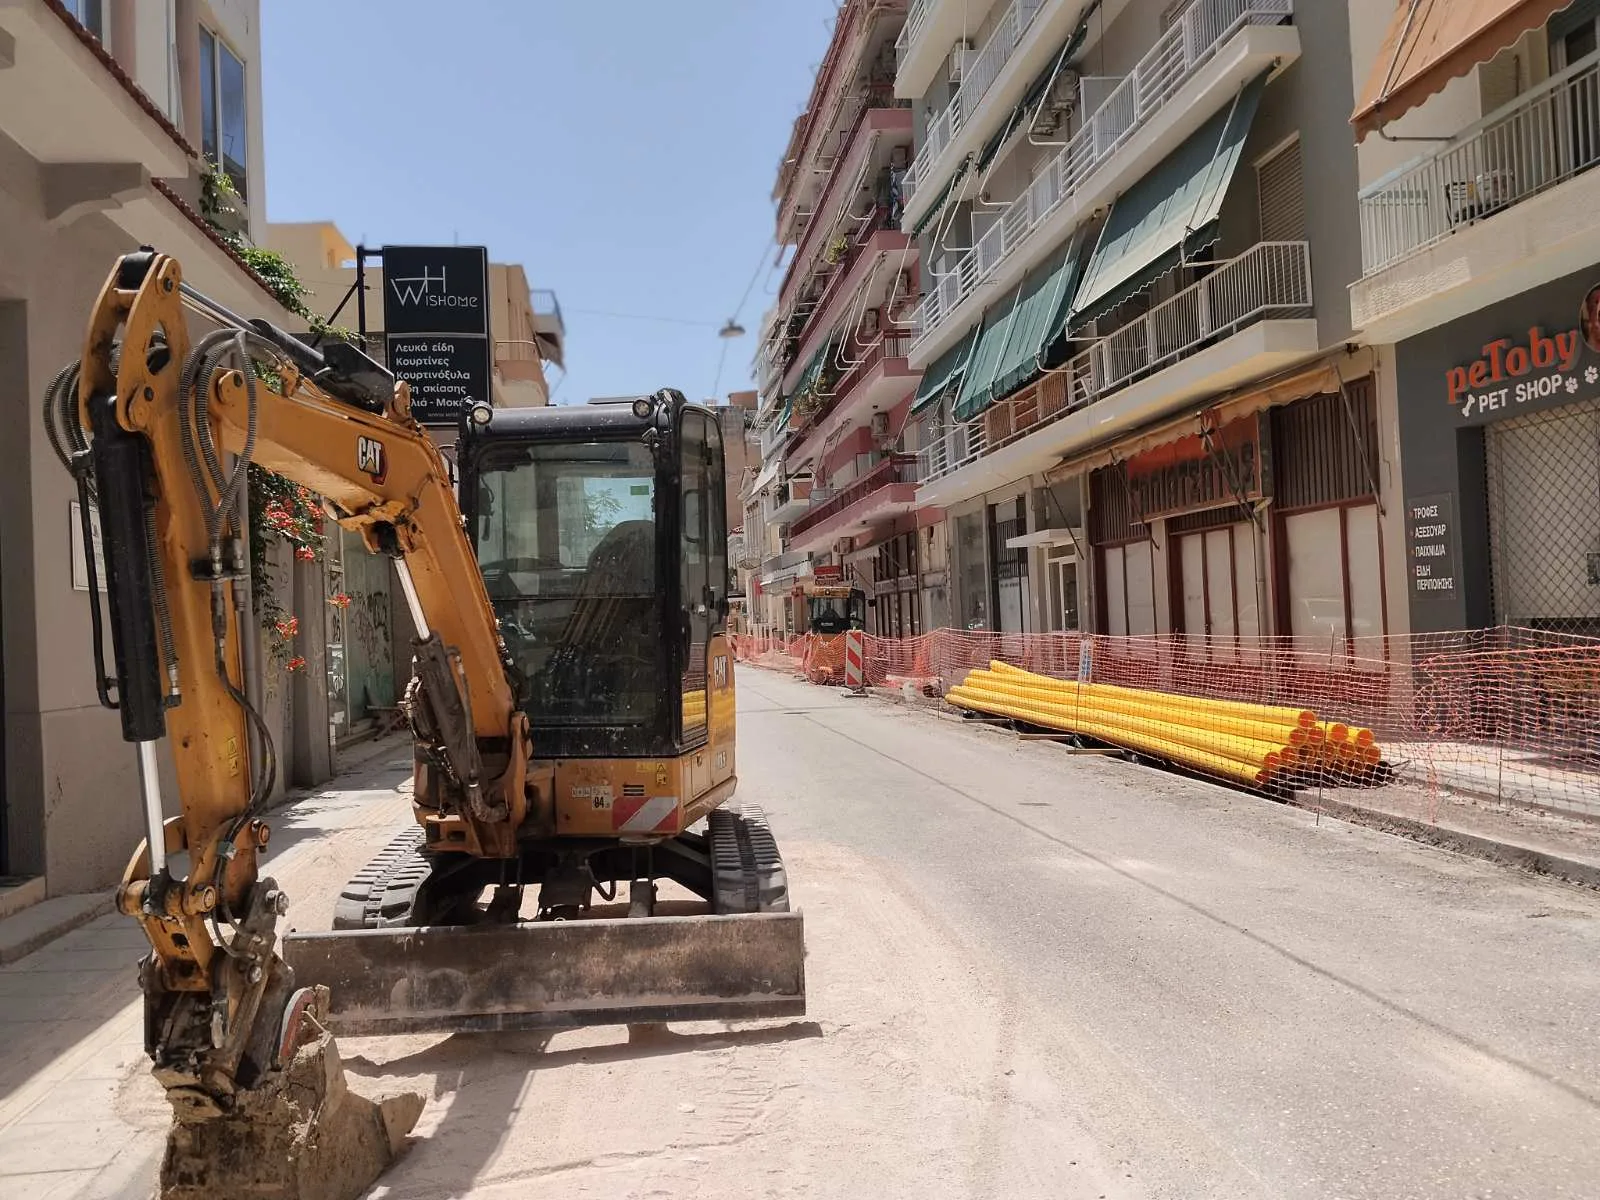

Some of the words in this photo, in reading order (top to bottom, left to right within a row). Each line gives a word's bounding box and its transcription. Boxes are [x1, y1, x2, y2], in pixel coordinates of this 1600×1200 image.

[395, 342, 428, 353] Λευκά
[432, 342, 455, 354] είδη
[395, 355, 450, 367] Κουρτίνες
[1446, 326, 1578, 404] peToby
[396, 369, 471, 381] Κουρτινόξυλα
[422, 383, 467, 395] σκίασης
[1478, 388, 1509, 413] PET
[1515, 374, 1562, 403] SHOP
[410, 397, 428, 407] λιά
[358, 436, 382, 474] CAT
[1413, 505, 1438, 519] ΤΡΟΦΕΣ
[1415, 524, 1446, 538] ΑΞΕΣΟΥΑΡ
[1416, 564, 1431, 576] ΕΙΔΗ
